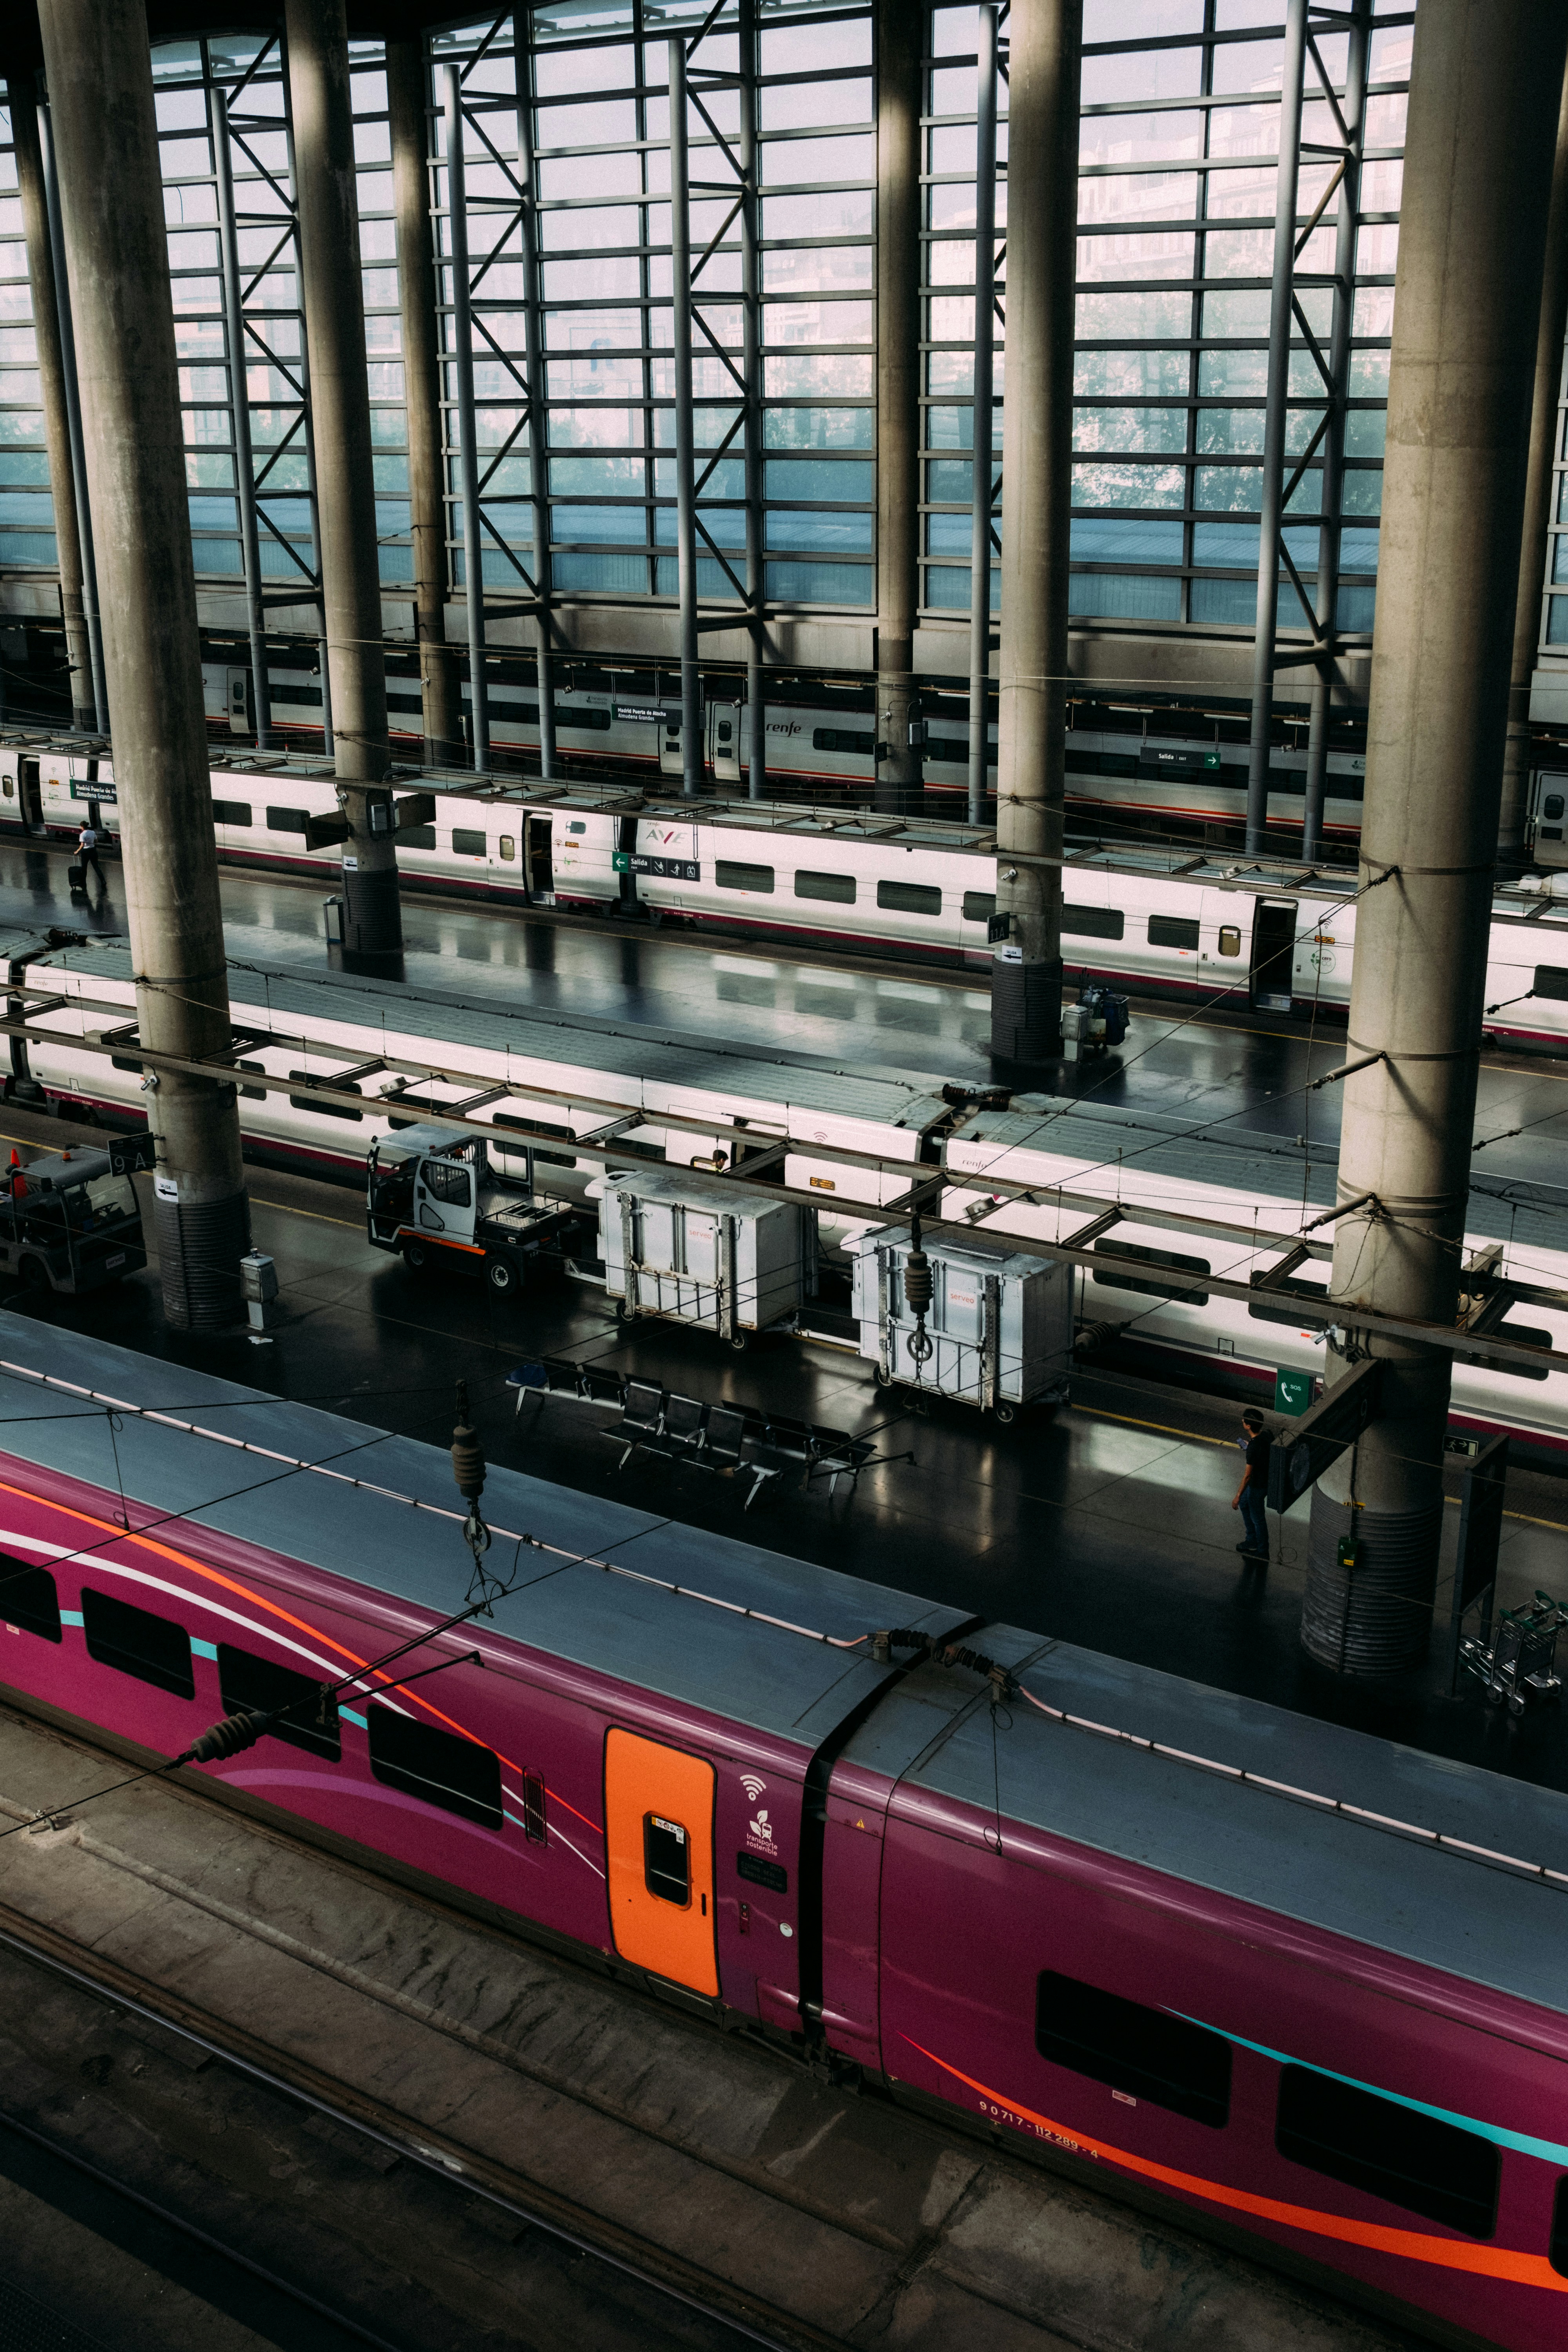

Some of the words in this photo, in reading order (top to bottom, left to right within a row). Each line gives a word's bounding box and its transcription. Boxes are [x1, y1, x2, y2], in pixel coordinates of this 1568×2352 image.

[766, 721, 801, 737] renfe
[646, 829, 688, 844] AVE
[990, 926, 1005, 942] 11A
[114, 1156, 125, 1173] 9
[135, 1152, 146, 1169] A
[962, 1160, 987, 1169] renfe
[689, 1230, 711, 1239] serveo
[951, 1293, 974, 1304] serveo
[747, 1833, 778, 1850] transporte
[747, 1840, 778, 1856] sostenible
[980, 2101, 987, 2110] 9
[1035, 2125, 1052, 2139] 112
[1055, 2134, 1078, 2150] 289
[1091, 2150, 1098, 2158] 4
